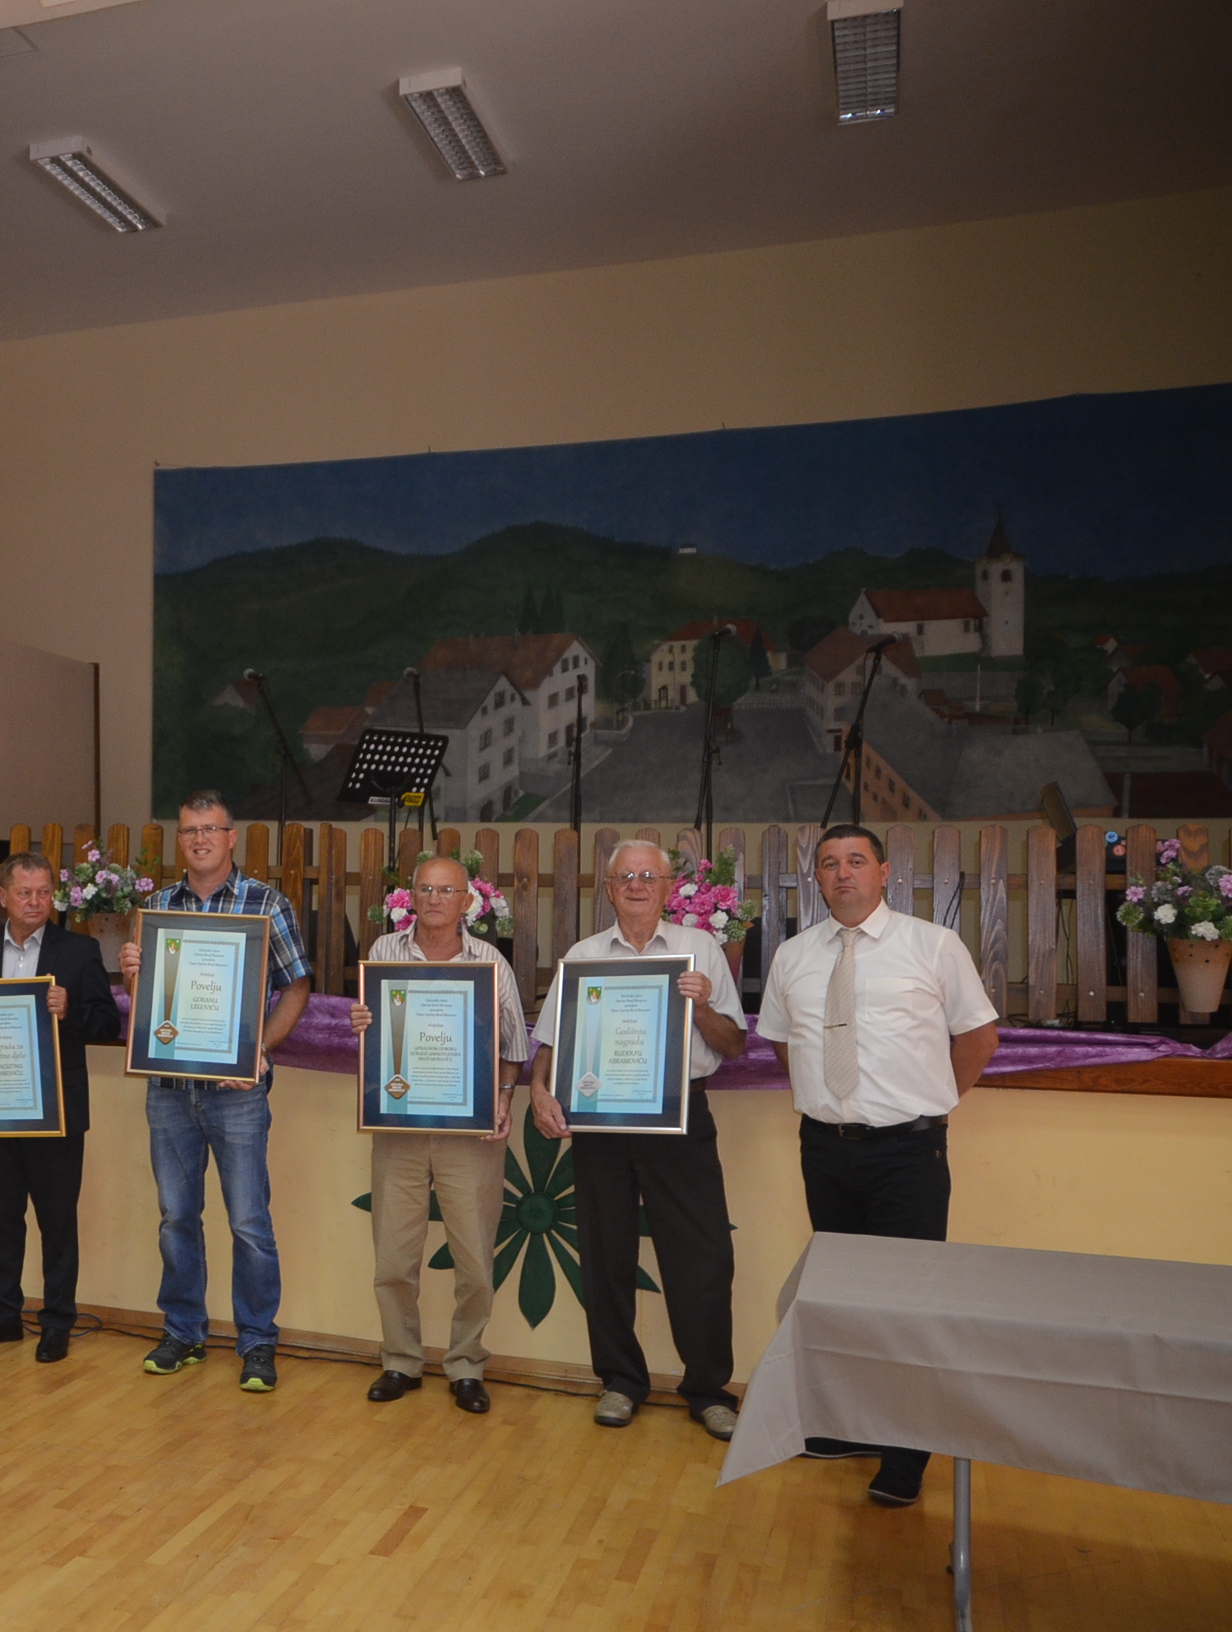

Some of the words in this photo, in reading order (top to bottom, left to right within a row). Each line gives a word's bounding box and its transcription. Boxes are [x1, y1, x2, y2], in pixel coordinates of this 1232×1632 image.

[190, 980, 222, 995] Povelju
[192, 996, 218, 1004] GORANU
[190, 1003, 219, 1011] LEGOVIĆU
[615, 1026, 646, 1036] Godišnju
[419, 1031, 452, 1046] Povelju
[615, 1036, 644, 1048] nagradu
[11, 1051, 26, 1061] djelo
